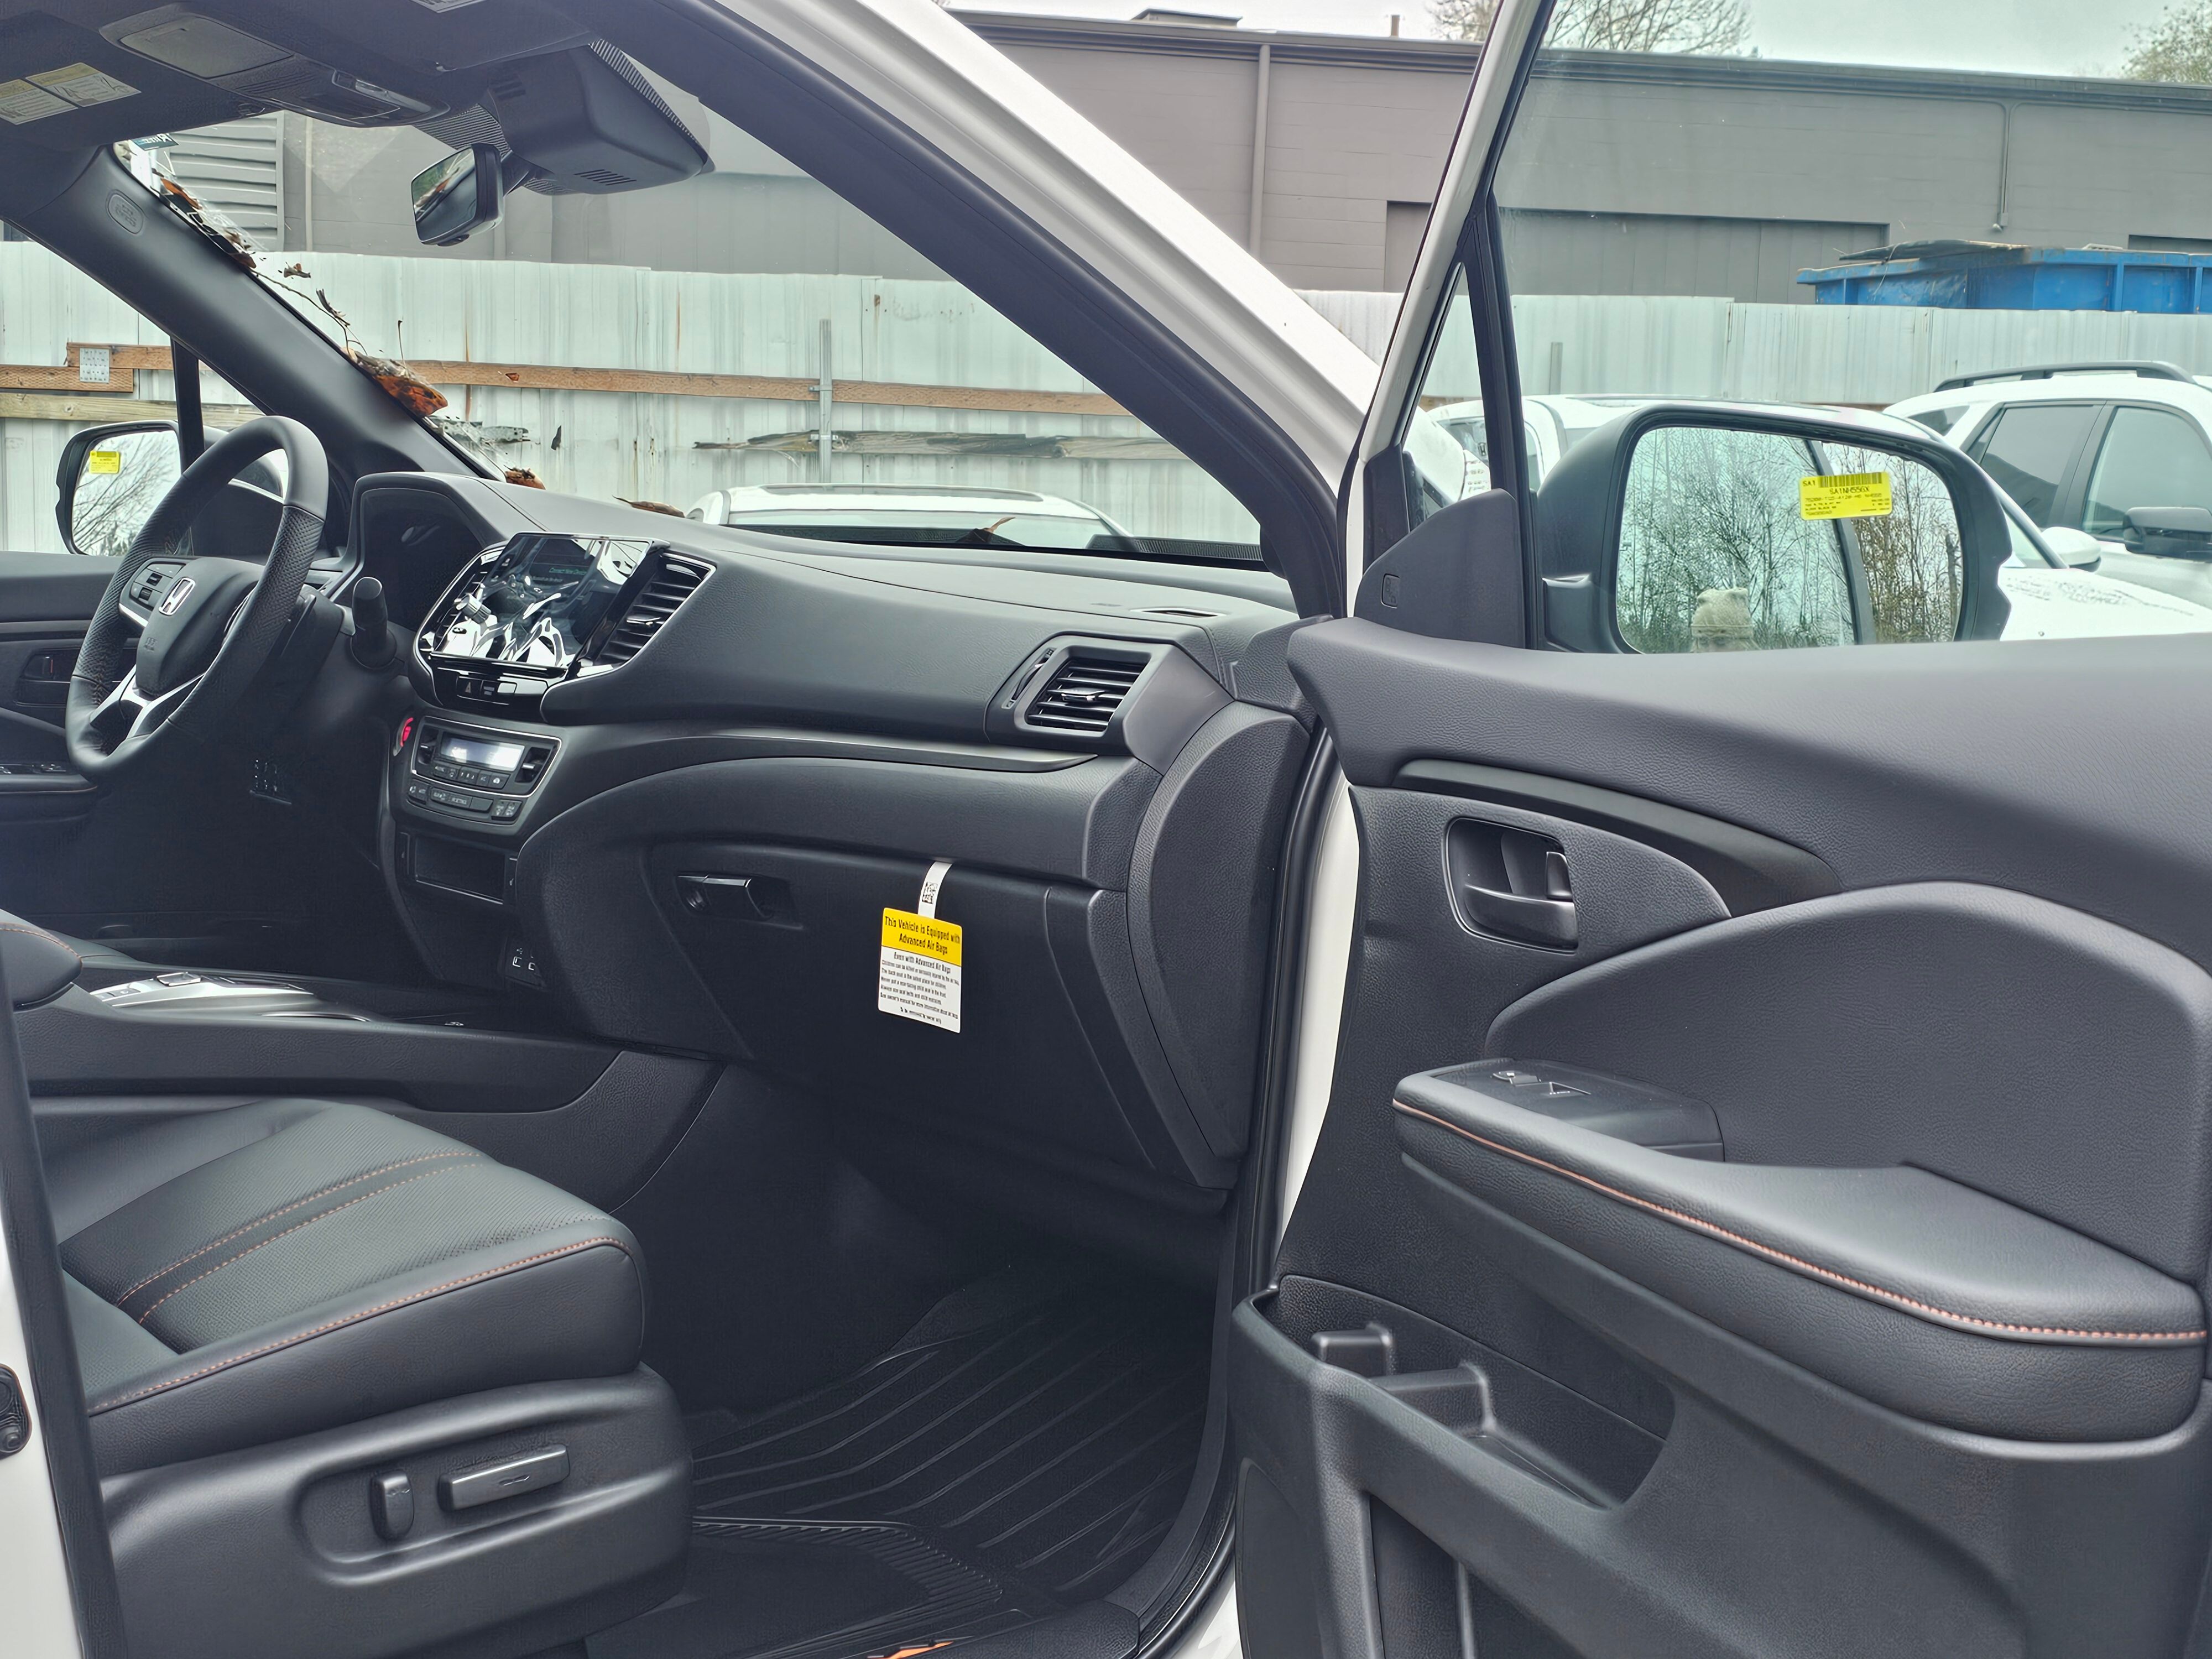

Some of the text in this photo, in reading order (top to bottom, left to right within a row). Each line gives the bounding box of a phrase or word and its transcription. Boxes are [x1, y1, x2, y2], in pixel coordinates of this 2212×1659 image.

[885, 916, 960, 944] This Vehicle is Equipped with
[899, 933, 926, 948] Advanced
[936, 942, 947, 955] Bags
[916, 957, 935, 969] Advanced
